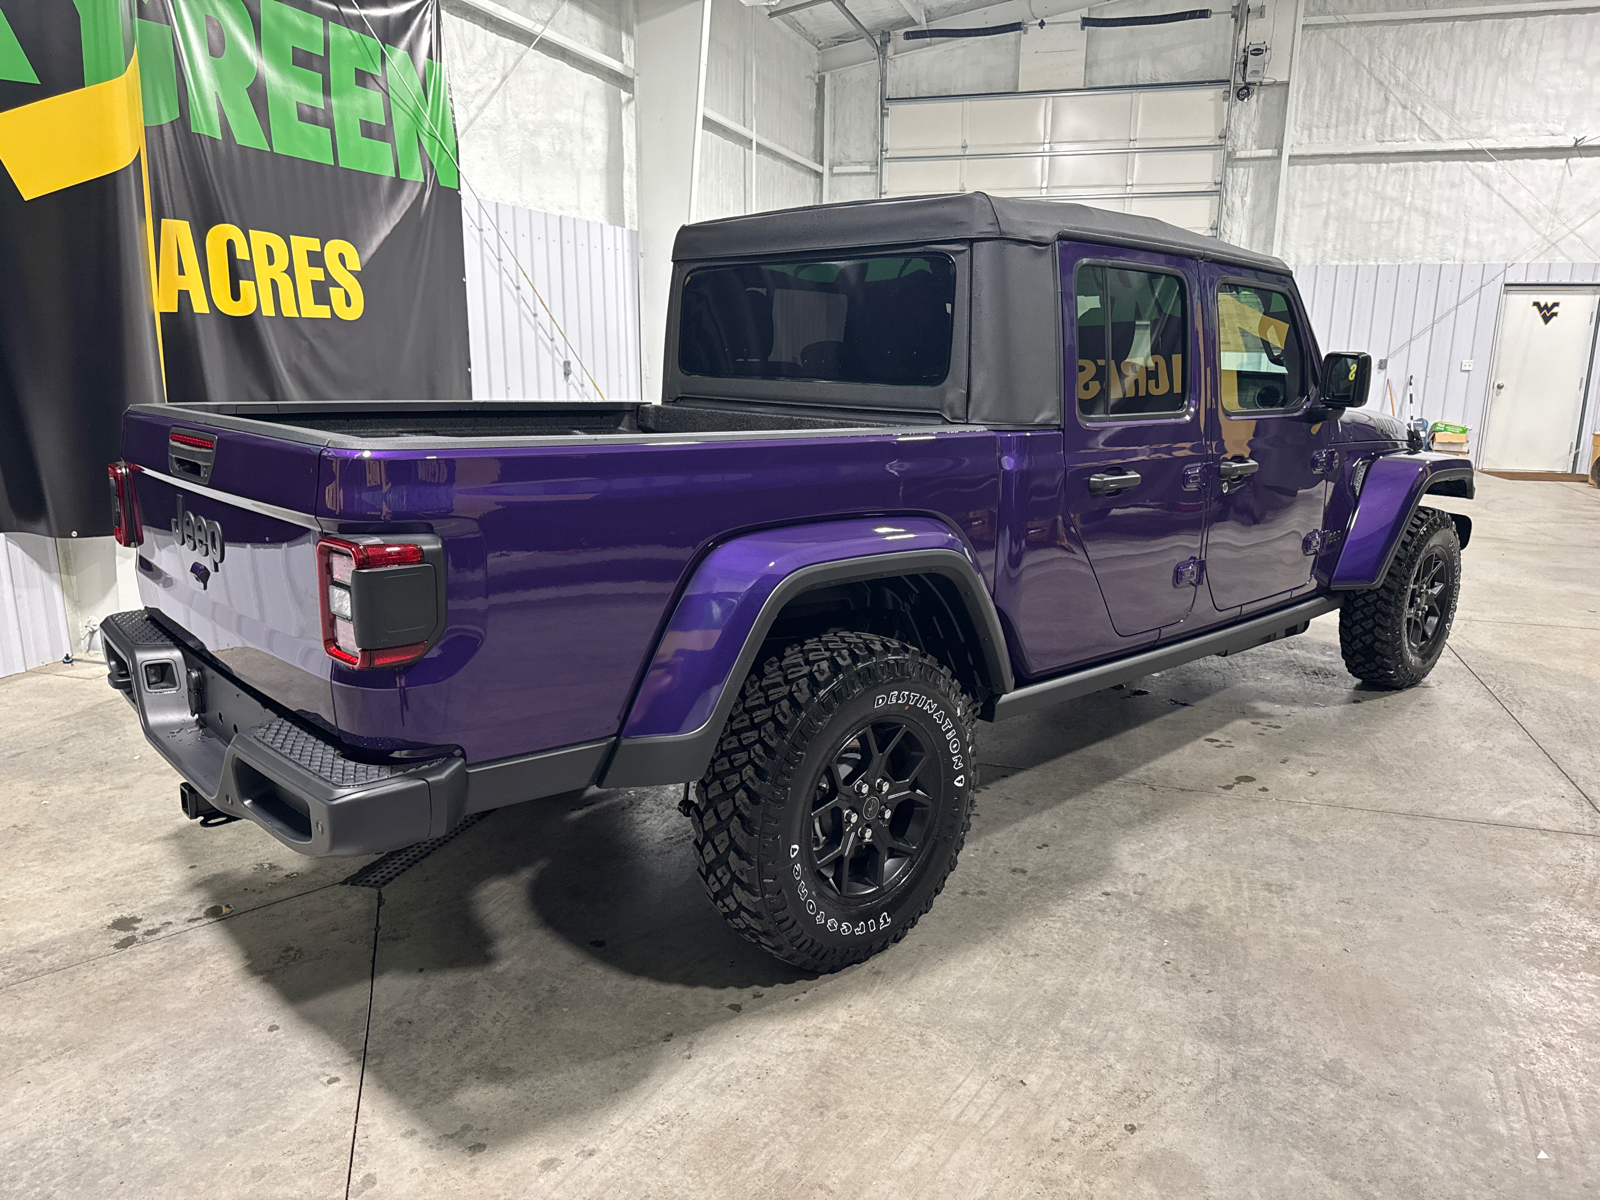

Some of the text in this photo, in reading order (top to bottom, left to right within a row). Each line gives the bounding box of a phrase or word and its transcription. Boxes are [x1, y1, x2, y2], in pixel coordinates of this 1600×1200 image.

[158, 218, 365, 320] ACRES
[171, 494, 225, 573] Jeep
[874, 690, 964, 770] DESTINATION
[793, 863, 891, 935] Firestone
